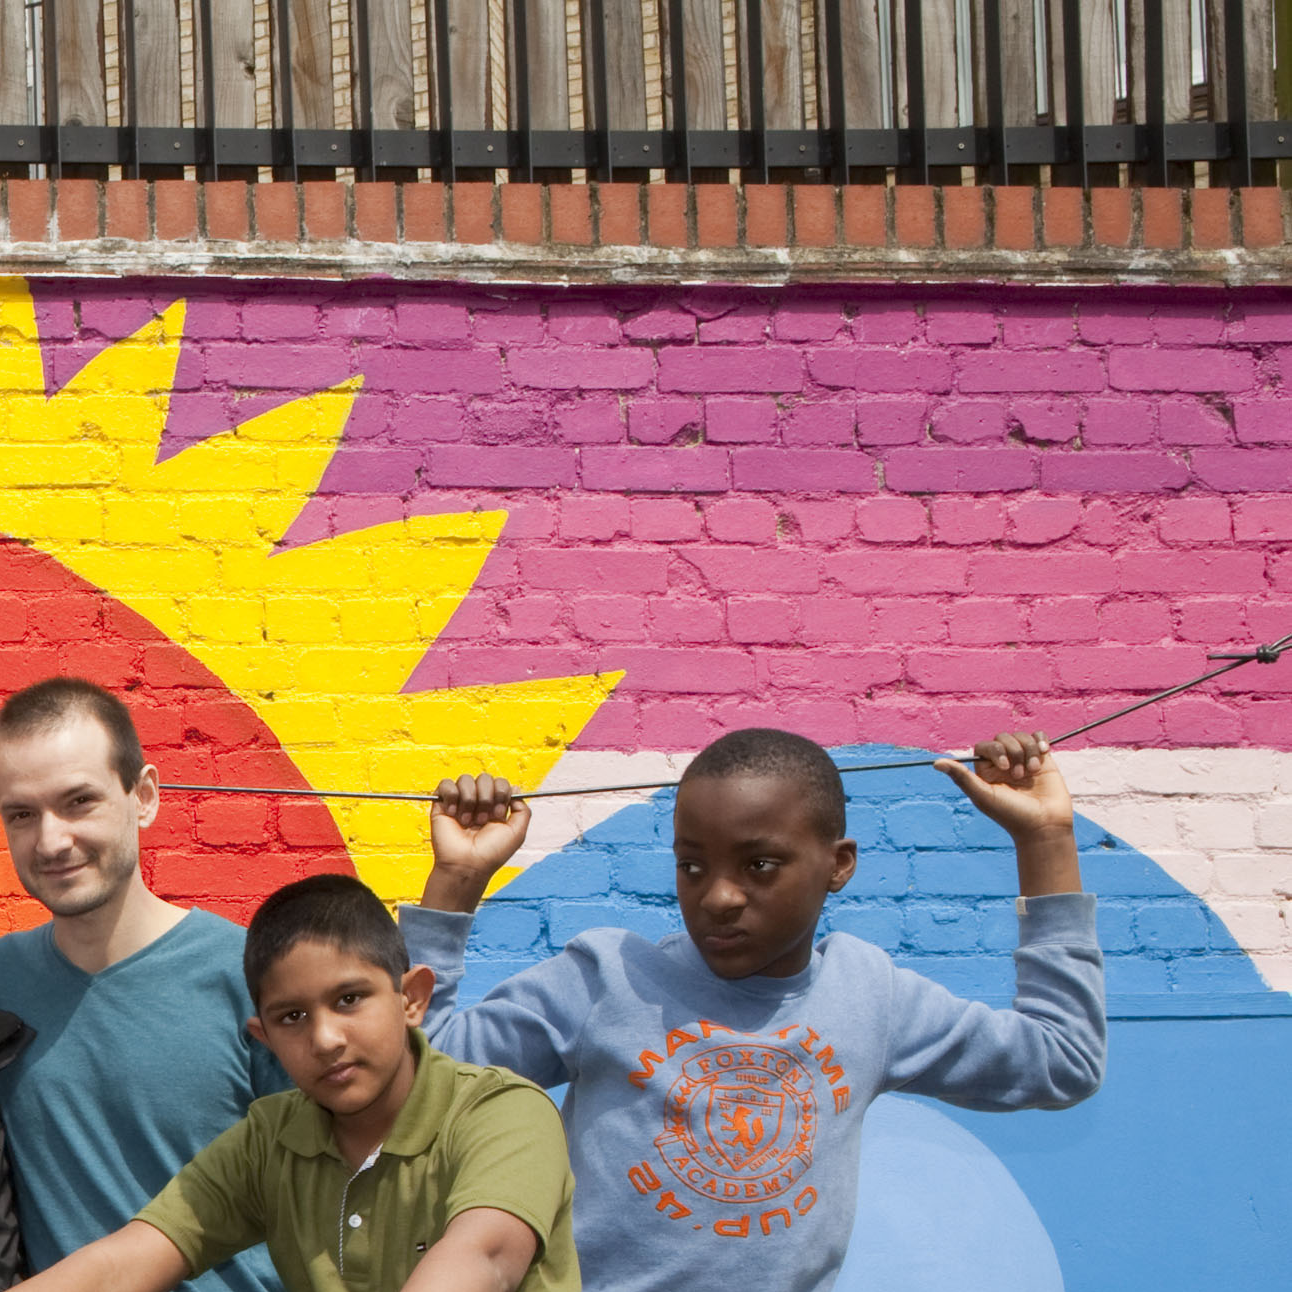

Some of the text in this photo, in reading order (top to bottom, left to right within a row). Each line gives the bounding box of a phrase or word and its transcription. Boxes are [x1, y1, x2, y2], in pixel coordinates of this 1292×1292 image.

[696, 1049, 804, 1085] FOXTON
[671, 1155, 795, 1198] ACADEMY
[713, 1185, 818, 1239] CUP
